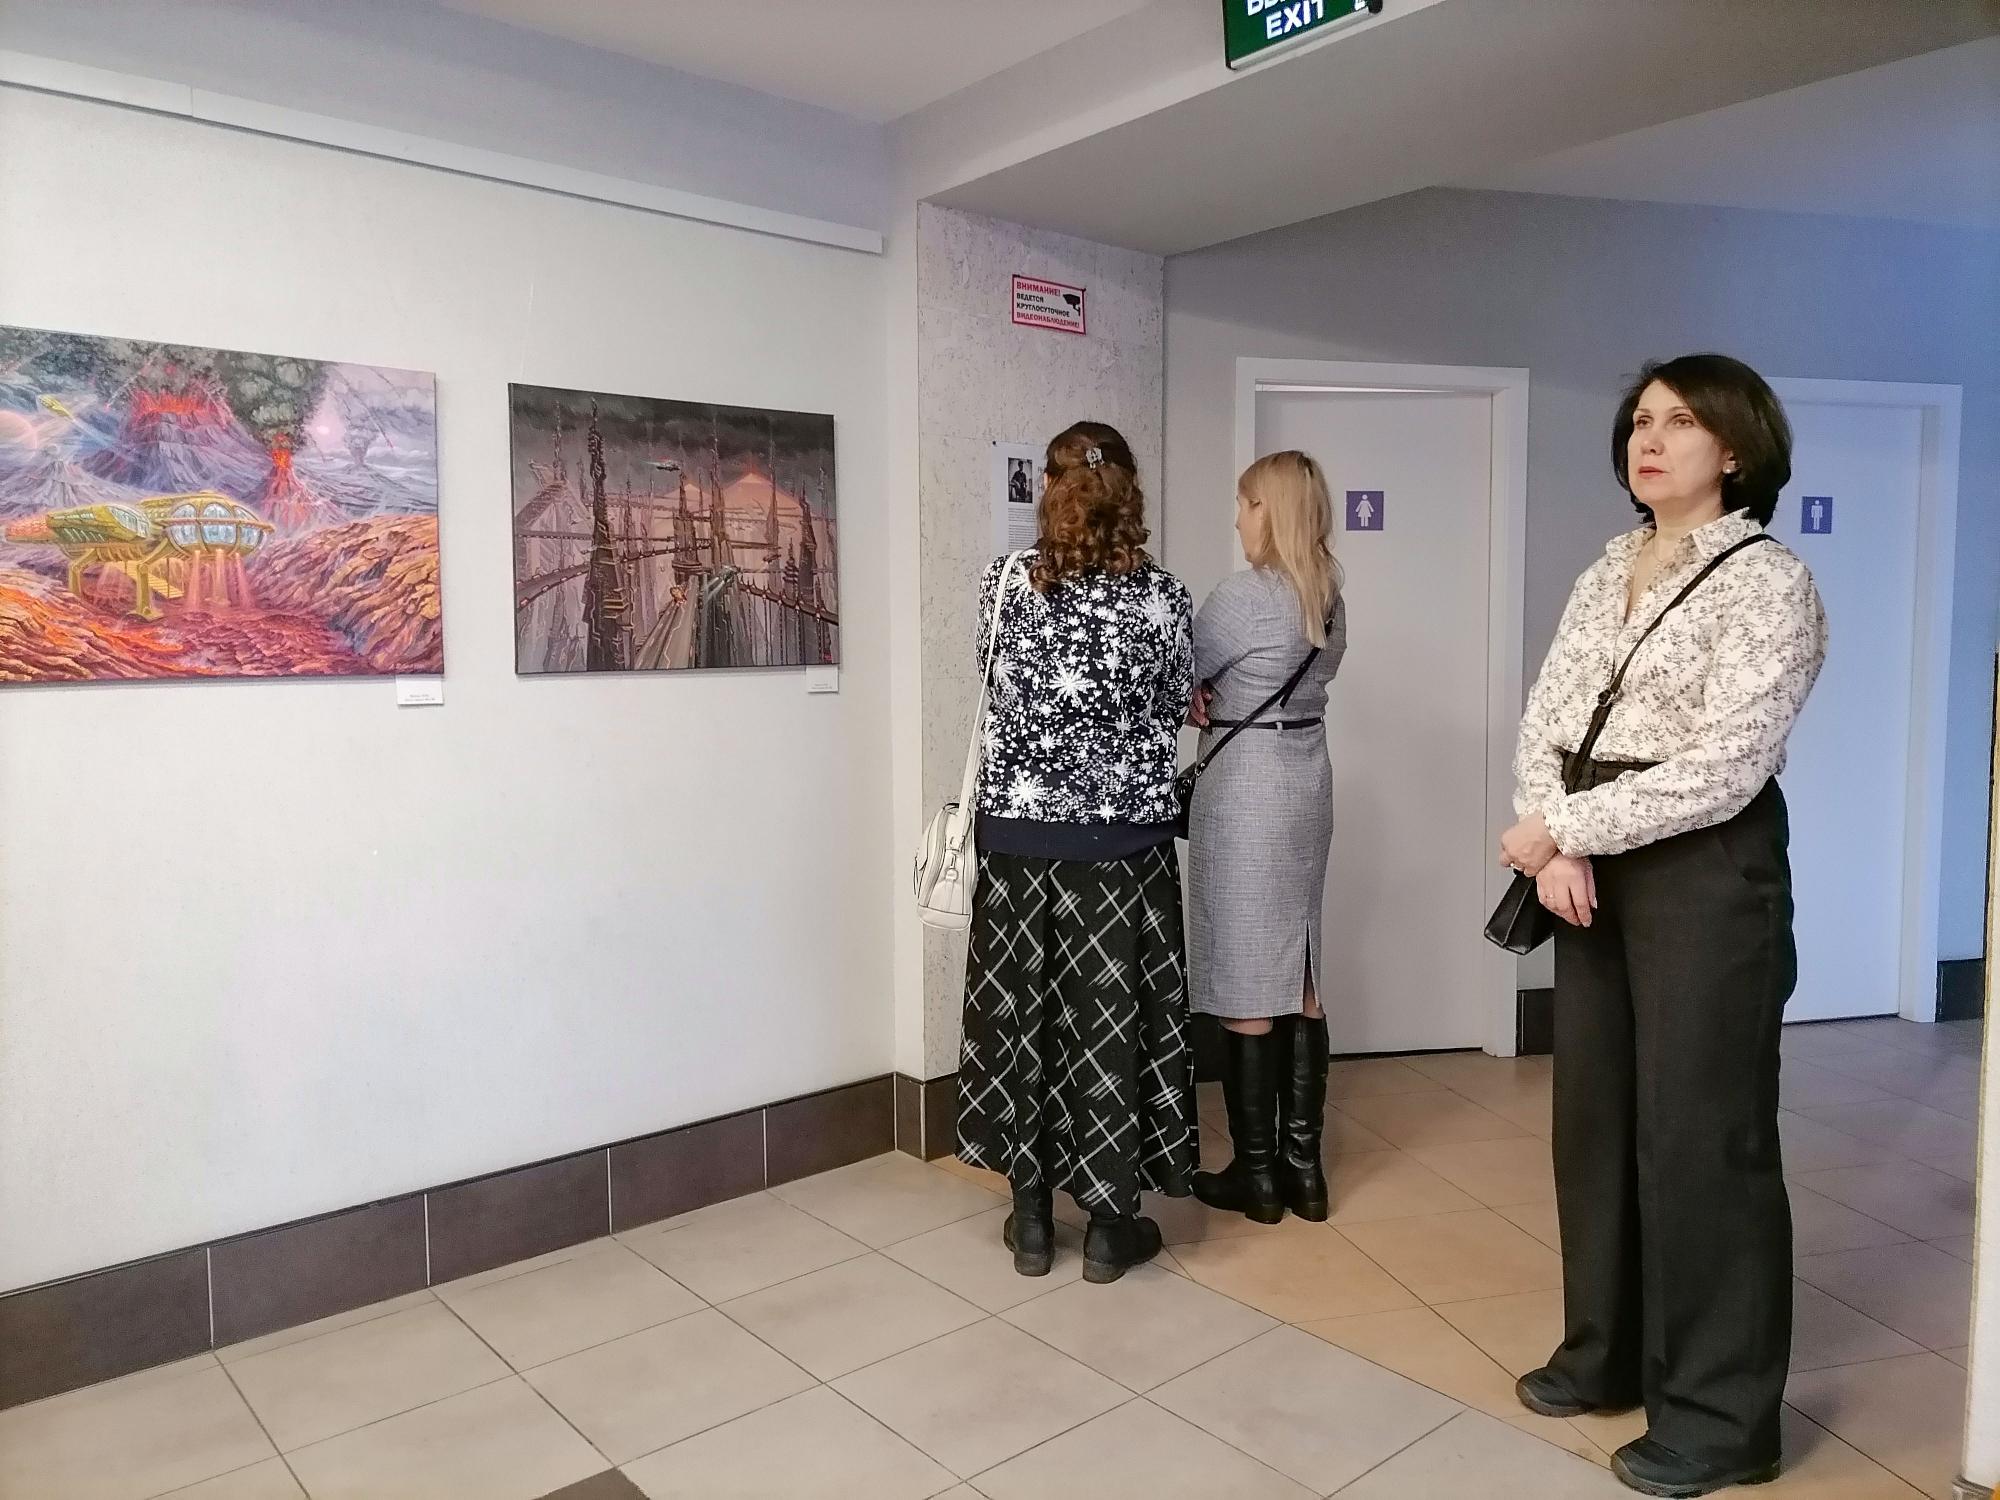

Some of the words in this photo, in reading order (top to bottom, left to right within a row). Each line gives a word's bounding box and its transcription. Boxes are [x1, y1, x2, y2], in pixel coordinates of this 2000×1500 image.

[1266, 0, 1324, 39] EXIT
[1016, 281, 1061, 297] ВНИМАНИЕ!
[1016, 293, 1044, 303] ВЕДЕТСЯ
[1016, 302, 1070, 317] КРУГЛОСУТОЧНОЕ
[1016, 311, 1080, 328] ВИДЕОНАБЛЮДЕНИЕ!
